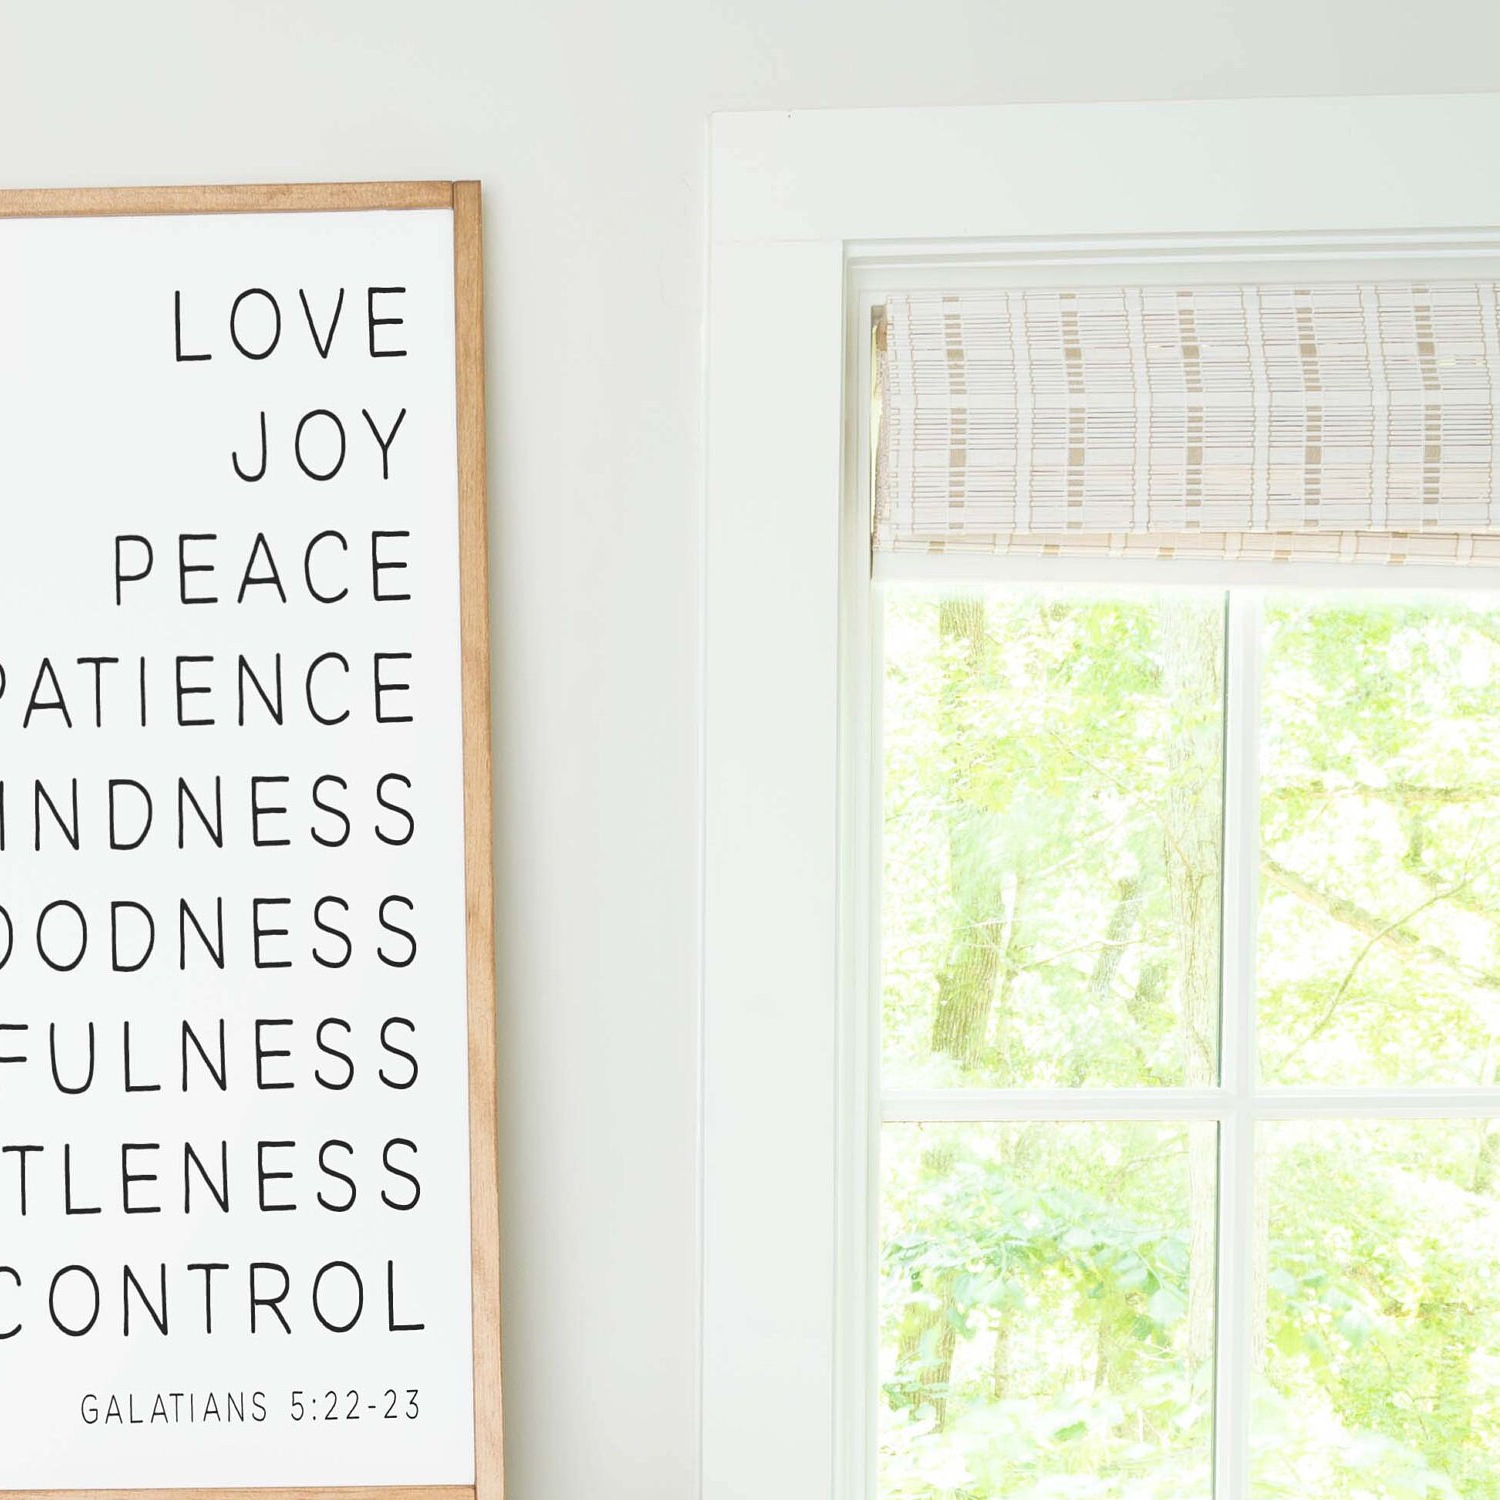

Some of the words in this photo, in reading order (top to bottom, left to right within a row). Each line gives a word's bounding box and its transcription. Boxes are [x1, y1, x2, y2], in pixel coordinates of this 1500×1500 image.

[175, 287, 409, 361] LOVE
[232, 408, 408, 482] JOY
[116, 531, 412, 605] PEACE
[80, 1391, 268, 1424] GALATIANS
[290, 1388, 420, 1422] 5:22-23
